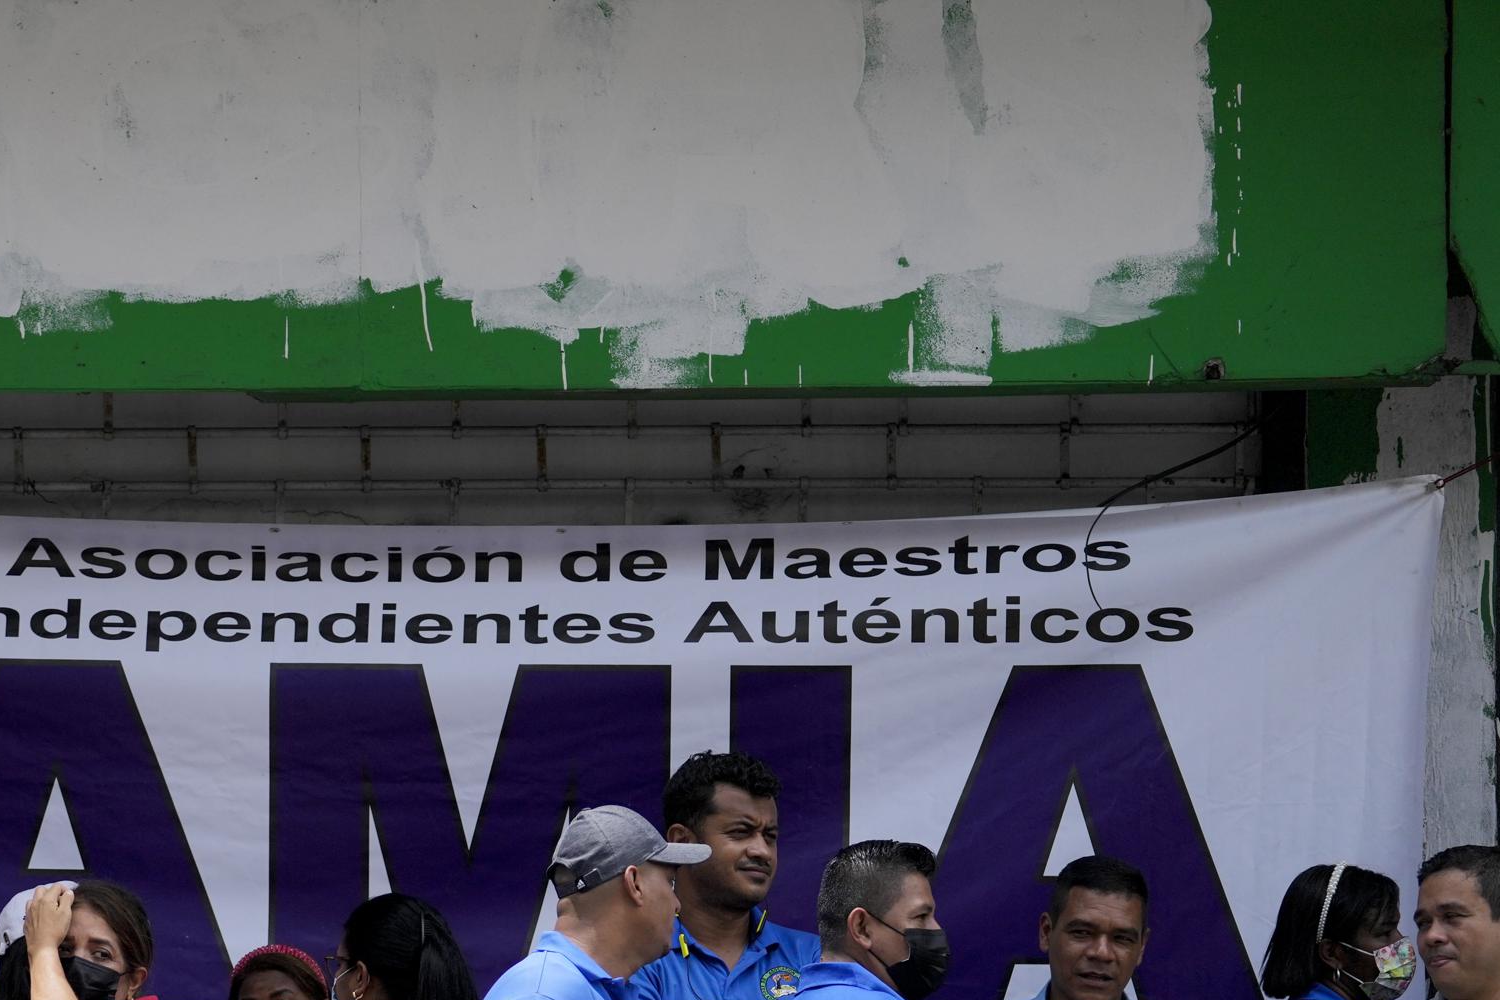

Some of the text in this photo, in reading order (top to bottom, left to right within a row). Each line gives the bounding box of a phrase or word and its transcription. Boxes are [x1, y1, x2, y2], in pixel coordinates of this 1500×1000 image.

[5, 535, 1132, 583] Asociación de Maestros
[684, 596, 1195, 643] Auténticos
